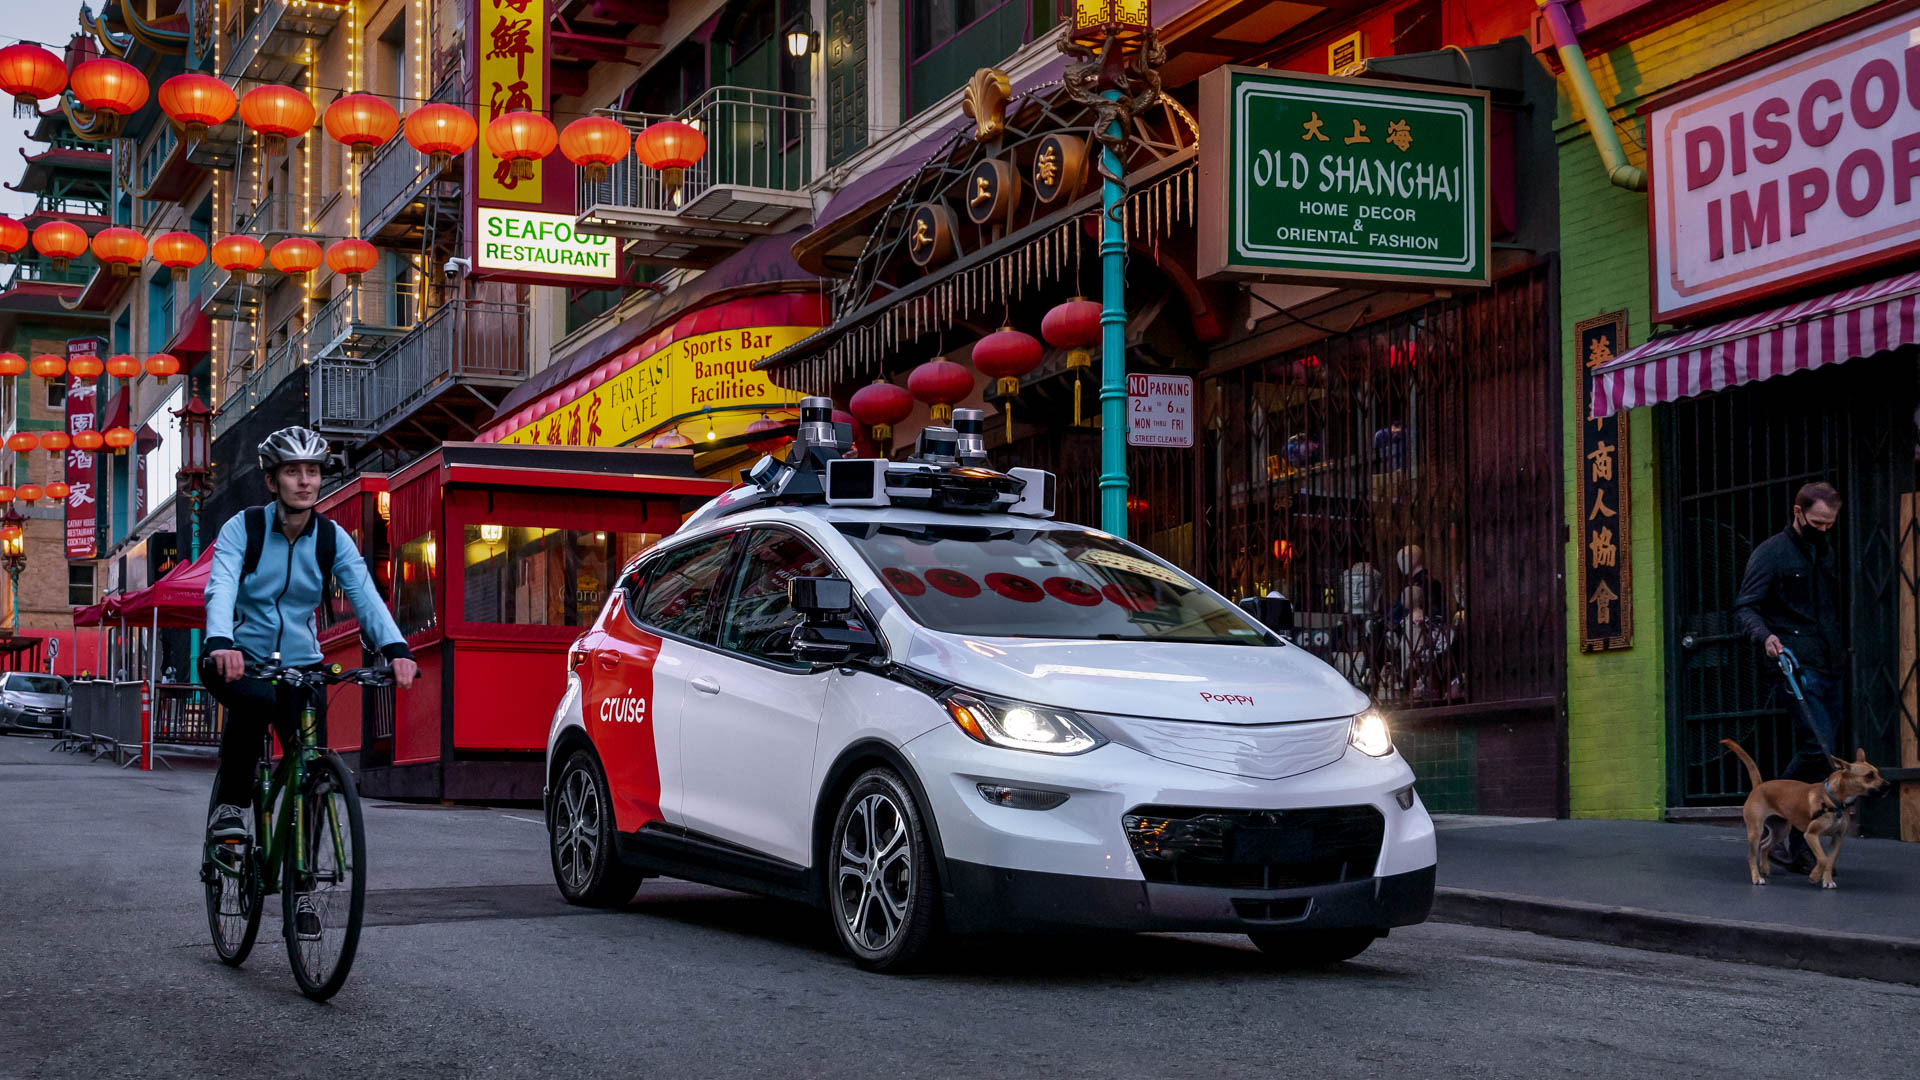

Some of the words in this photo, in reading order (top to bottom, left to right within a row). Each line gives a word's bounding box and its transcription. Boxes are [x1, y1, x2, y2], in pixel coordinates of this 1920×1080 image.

[1301, 111, 1414, 152] 大上海
[1253, 149, 1309, 190] OLD
[1318, 155, 1460, 203] SHANGHAI
[1300, 201, 1348, 217] HOME
[1359, 205, 1416, 222] DECOR
[1352, 218, 1364, 232] &
[1276, 227, 1359, 245] ORIENTAL
[1369, 233, 1438, 250] FASHION
[486, 243, 611, 268] RESTAURANT
[682, 335, 732, 361] Sports
[741, 331, 773, 350] Bar
[694, 355, 766, 380] Banque
[611, 376, 634, 409] FAR
[638, 353, 672, 394] EAST
[690, 379, 766, 405] Facilities
[1129, 377, 1147, 395] NO
[1150, 382, 1189, 397] PARKING
[1134, 399, 1142, 412] 2
[1167, 400, 1174, 413] 6
[1135, 418, 1151, 429] MON
[1171, 419, 1184, 430] FRI
[1134, 434, 1156, 443] STREET
[1157, 436, 1188, 444] CLEANING
[1586, 335, 1619, 625] 華商人協會
[600, 687, 646, 723] cruise
[1199, 692, 1255, 707] Poppy
